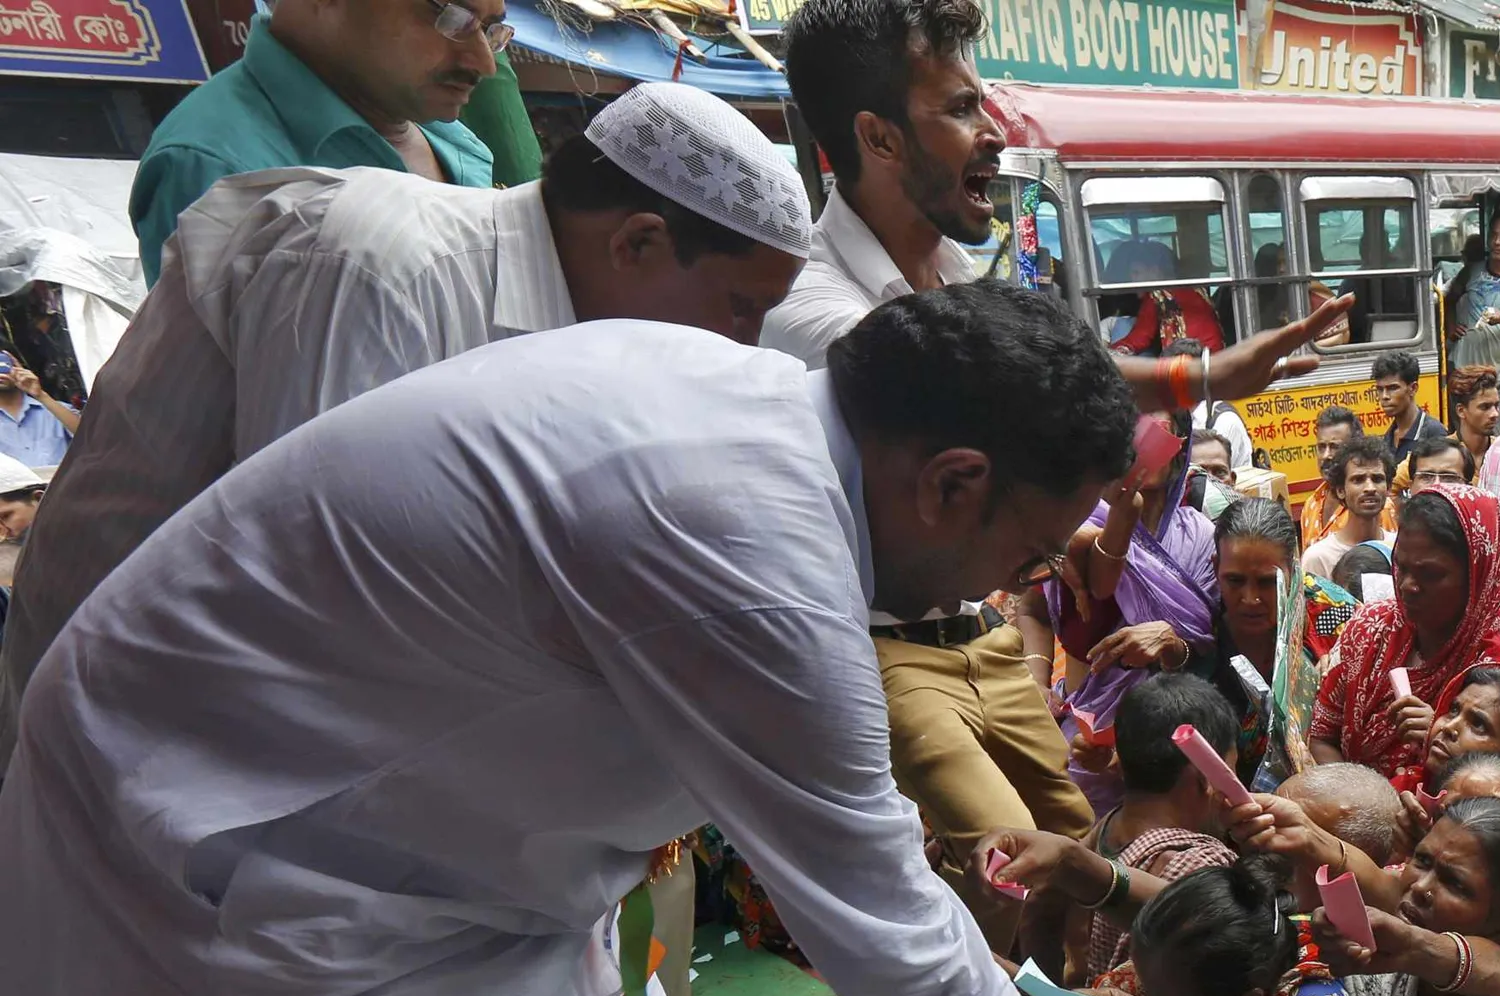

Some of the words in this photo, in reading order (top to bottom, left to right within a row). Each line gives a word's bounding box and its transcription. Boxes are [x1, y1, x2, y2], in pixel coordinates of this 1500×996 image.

[979, 0, 1067, 72] RAFIQ
[1072, 0, 1141, 73] BOOT
[1148, 3, 1233, 80] HOUSE
